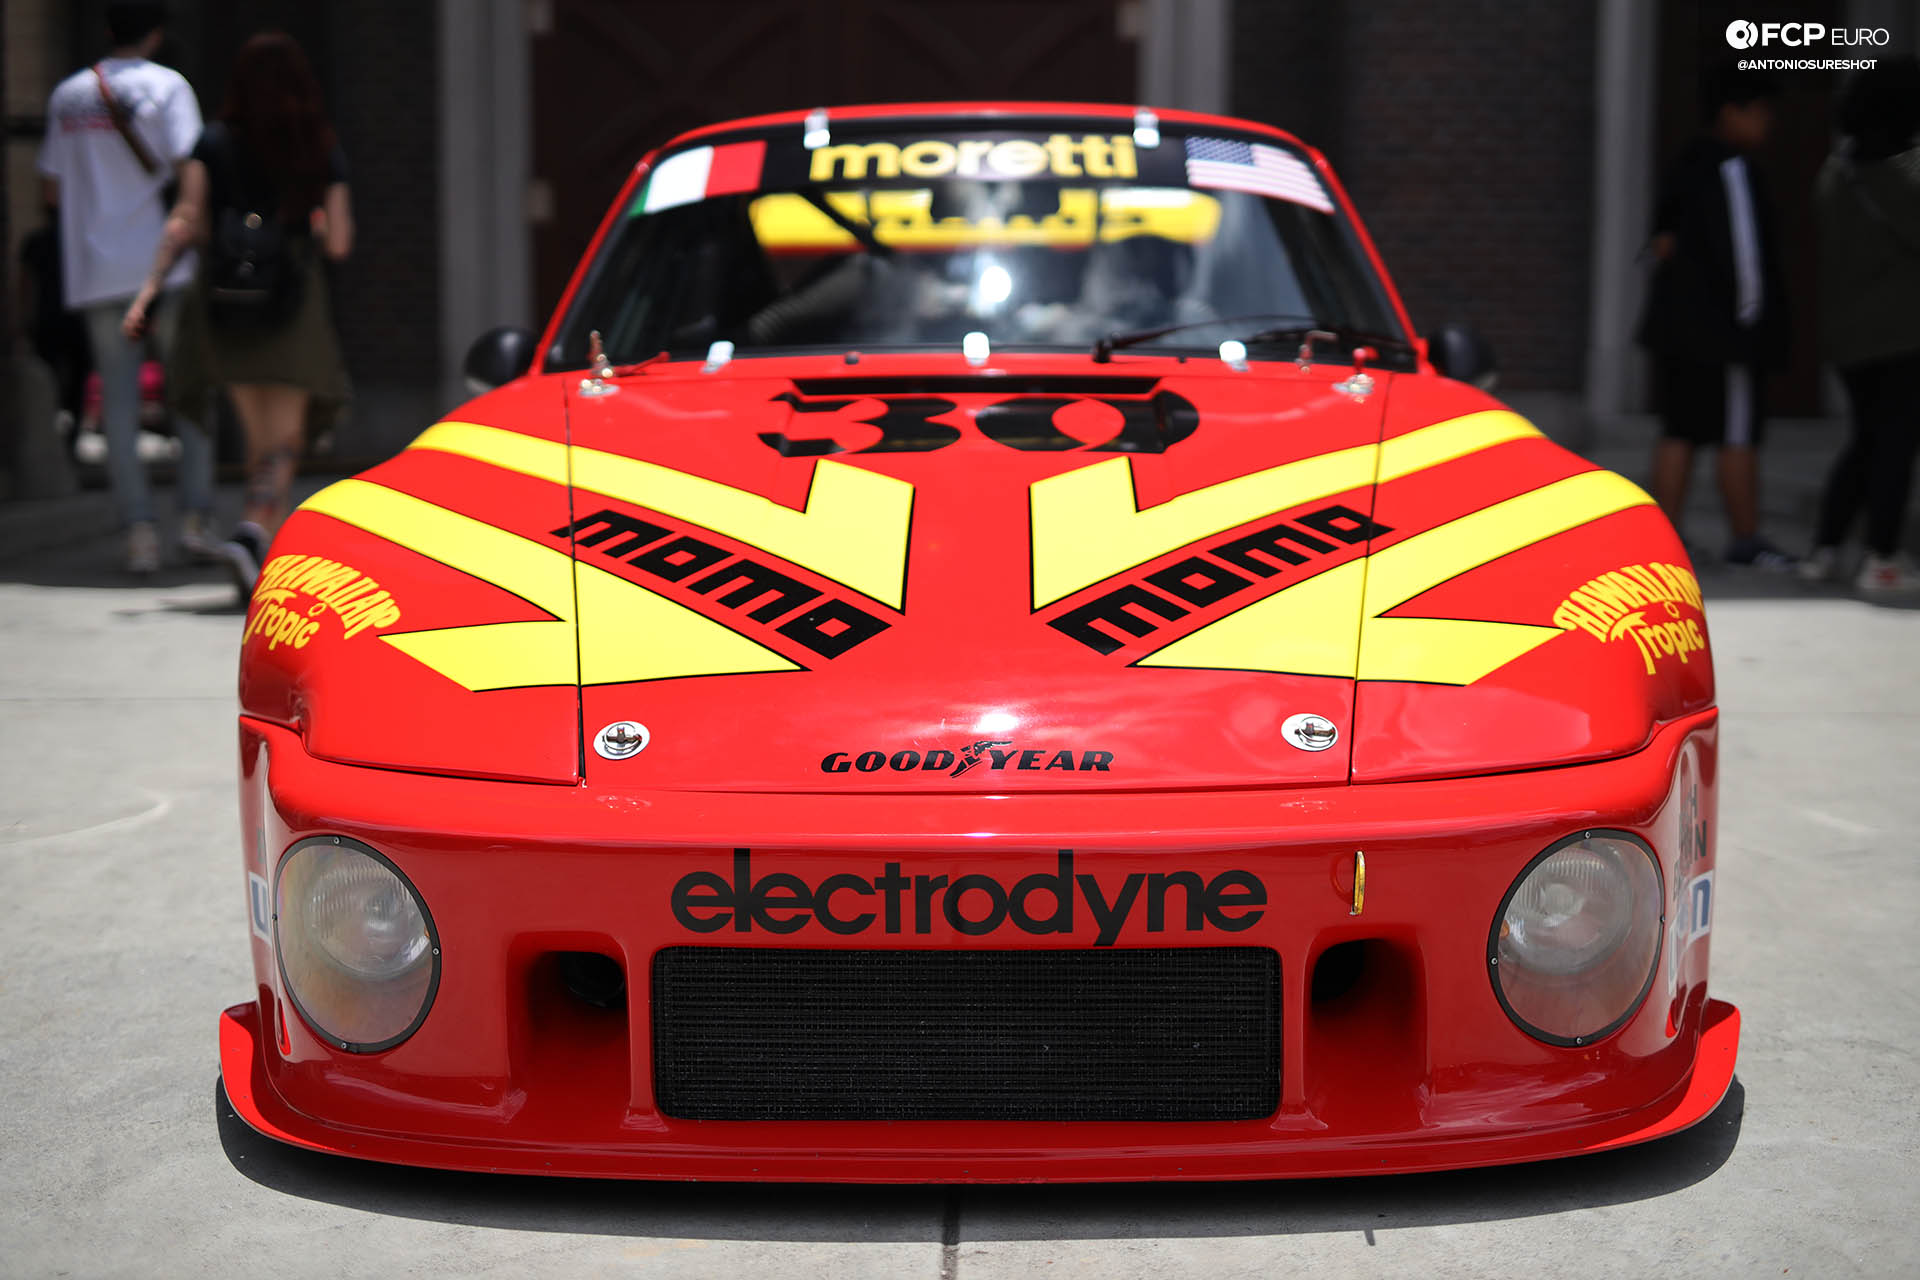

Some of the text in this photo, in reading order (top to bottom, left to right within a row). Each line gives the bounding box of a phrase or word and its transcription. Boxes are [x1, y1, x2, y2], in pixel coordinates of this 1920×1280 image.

[809, 134, 1138, 181] moretti
[1610, 611, 1705, 675] Tropic
[671, 848, 1268, 946] electrodyne
